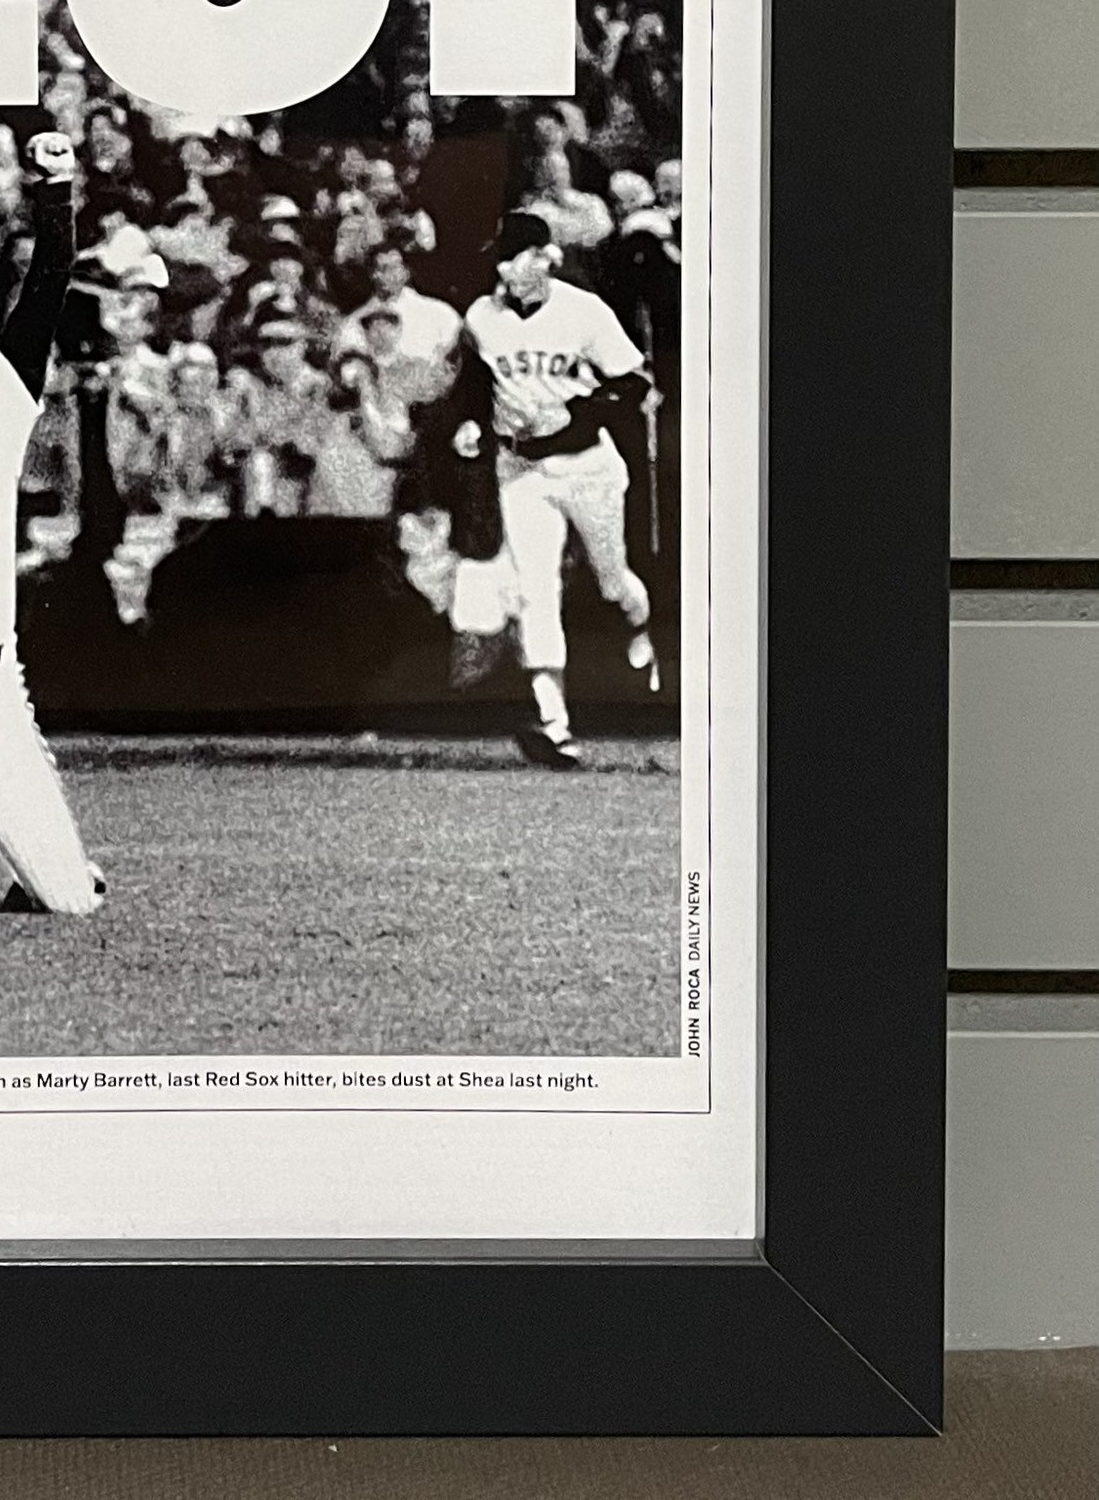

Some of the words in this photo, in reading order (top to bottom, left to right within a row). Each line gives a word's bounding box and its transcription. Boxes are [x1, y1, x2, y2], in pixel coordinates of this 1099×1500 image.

[687, 871, 701, 916] NEWS
[687, 919, 701, 961] DAILY
[687, 968, 701, 1010] ROCA
[687, 1017, 701, 1058] JOHN
[11, 1076, 32, 1089] as
[37, 1073, 90, 1092] Marty
[95, 1072, 162, 1089] Barrett,
[168, 1071, 201, 1087] last
[206, 1071, 240, 1087] Red
[246, 1071, 279, 1087] Sox
[284, 1071, 337, 1088] hitter,
[342, 1071, 387, 1087] bites
[392, 1071, 431, 1087] dust
[437, 1073, 454, 1087] at
[460, 1072, 505, 1087] Shea
[510, 1072, 543, 1088] last
[548, 1072, 599, 1092] night.
